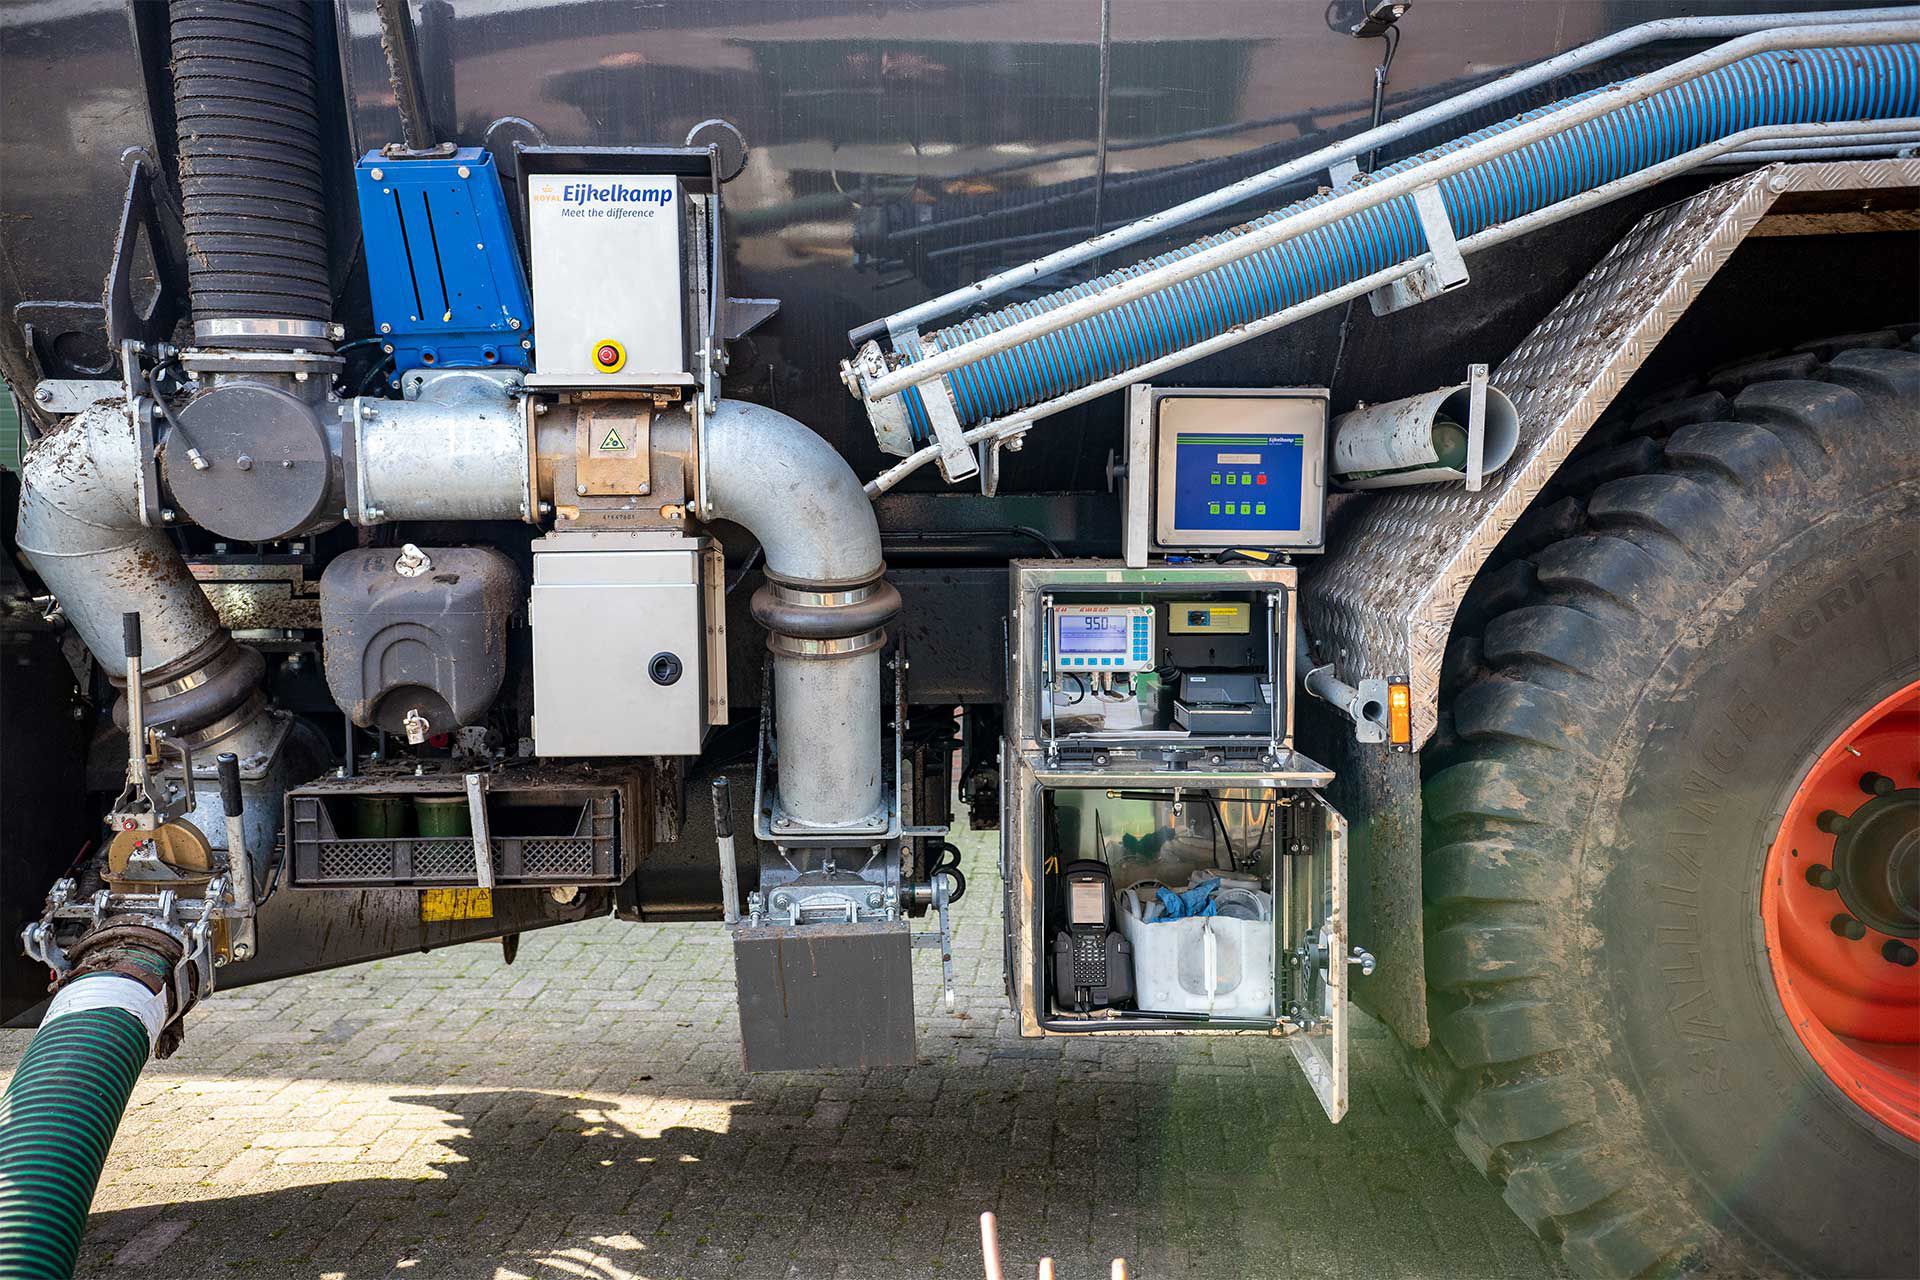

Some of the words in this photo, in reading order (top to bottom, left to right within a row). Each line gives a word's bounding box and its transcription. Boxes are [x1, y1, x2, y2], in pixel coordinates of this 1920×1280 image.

[563, 184, 673, 207] Eijkelkamp
[561, 208, 585, 218] Meet
[588, 208, 604, 218] the
[606, 208, 655, 220] difference
[1085, 616, 1109, 630] 950
